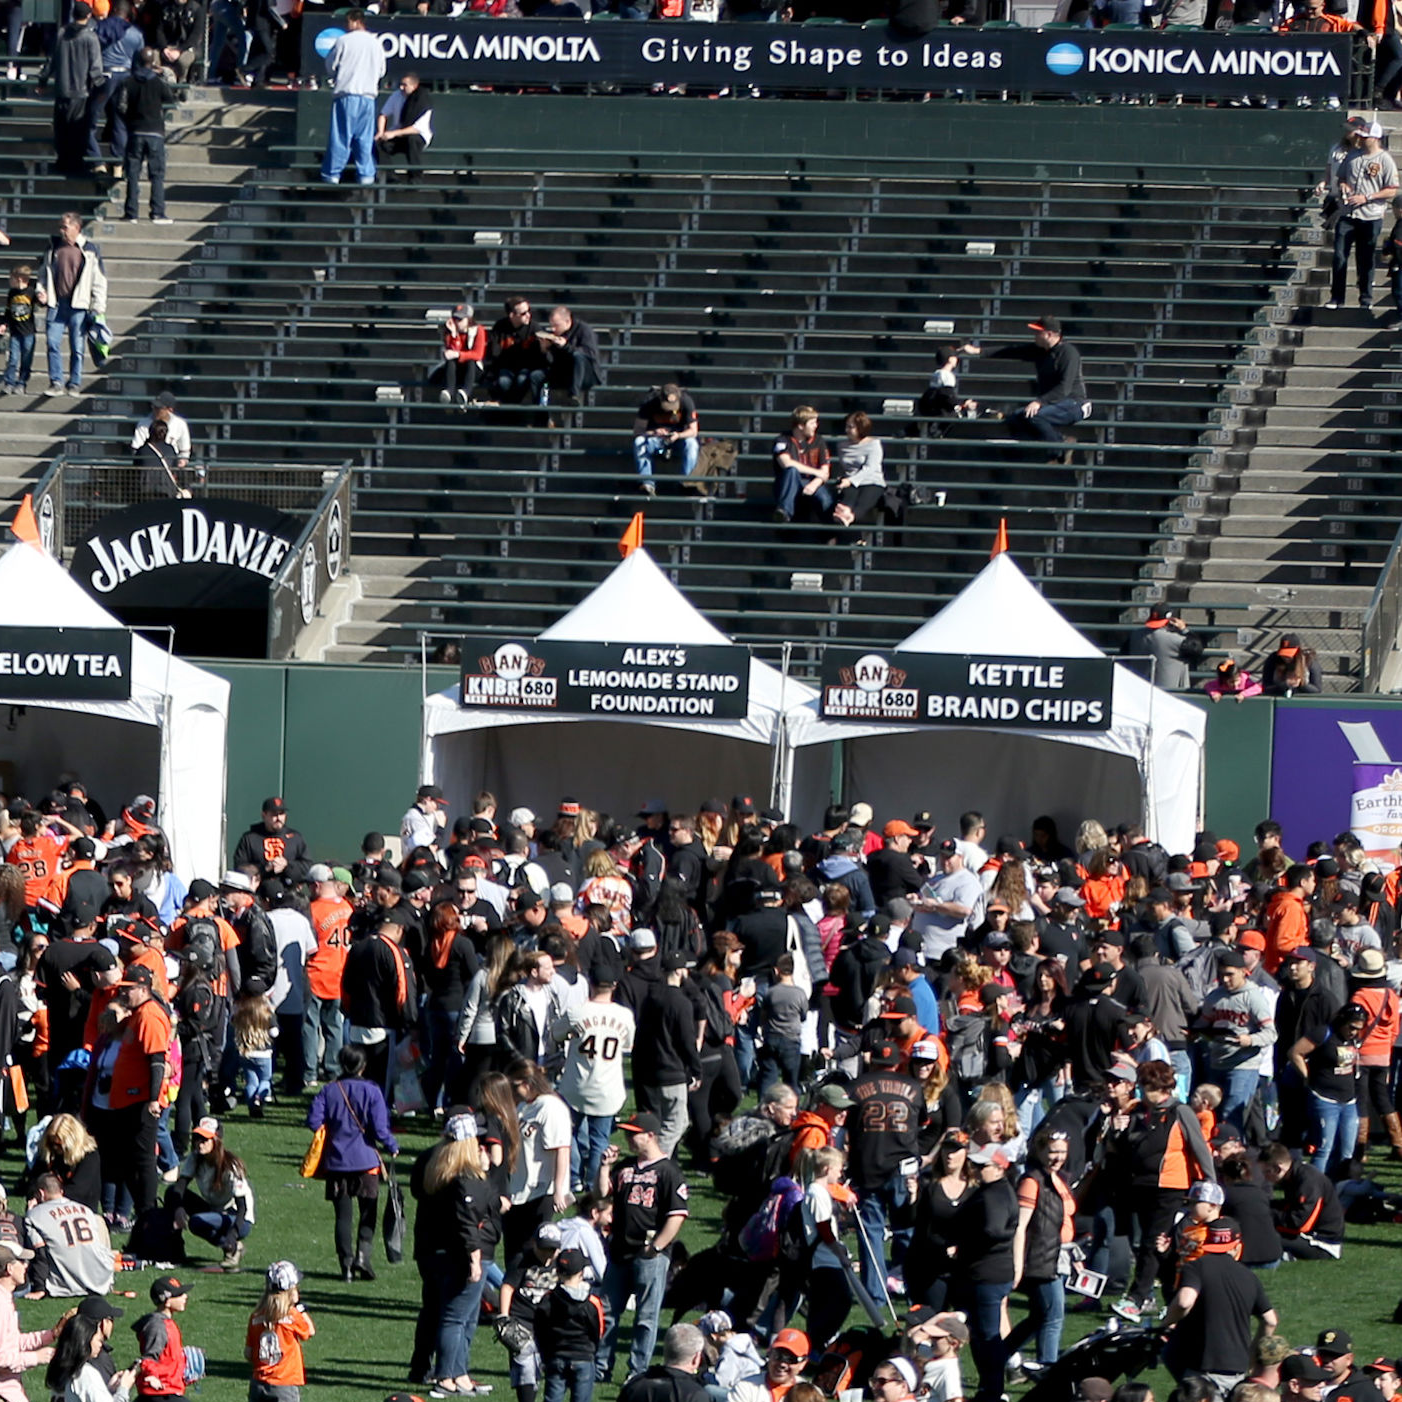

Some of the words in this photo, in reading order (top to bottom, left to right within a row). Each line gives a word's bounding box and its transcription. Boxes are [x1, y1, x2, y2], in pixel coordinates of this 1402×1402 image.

[377, 33, 468, 60] ONICA
[473, 35, 600, 62] MINOLTA
[641, 37, 752, 71] Giving
[769, 40, 861, 73] Shape
[877, 46, 908, 68] to
[923, 44, 1003, 69] Ideas
[1089, 47, 1205, 75] KONICA
[1209, 49, 1341, 76] MINOLTA
[87, 522, 180, 593] JACK
[181, 508, 290, 580] DANIE
[73, 654, 122, 677] TEA
[479, 654, 546, 676] GIANTS
[622, 648, 686, 667] ALEX'S
[468, 677, 520, 696] KNBR
[523, 679, 553, 695] 680
[568, 670, 672, 690] LEMONADE
[675, 673, 739, 692] STAND
[839, 666, 906, 688] GIANTS
[969, 663, 1064, 688] KETTLE
[591, 694, 714, 714] FOUNDATION
[828, 688, 880, 707] KNBR
[884, 691, 914, 707] 680
[927, 695, 1019, 720] BRAND
[1024, 699, 1103, 723] CHIPS
[326, 927, 353, 951] 40
[573, 1012, 633, 1045] UMGARNER
[579, 1034, 619, 1063] 40
[857, 1083, 880, 1101] THE
[882, 1079, 919, 1103] THRILL
[864, 1101, 911, 1133] 22
[48, 1204, 88, 1223] PAGAN
[58, 1217, 94, 1249] 16
